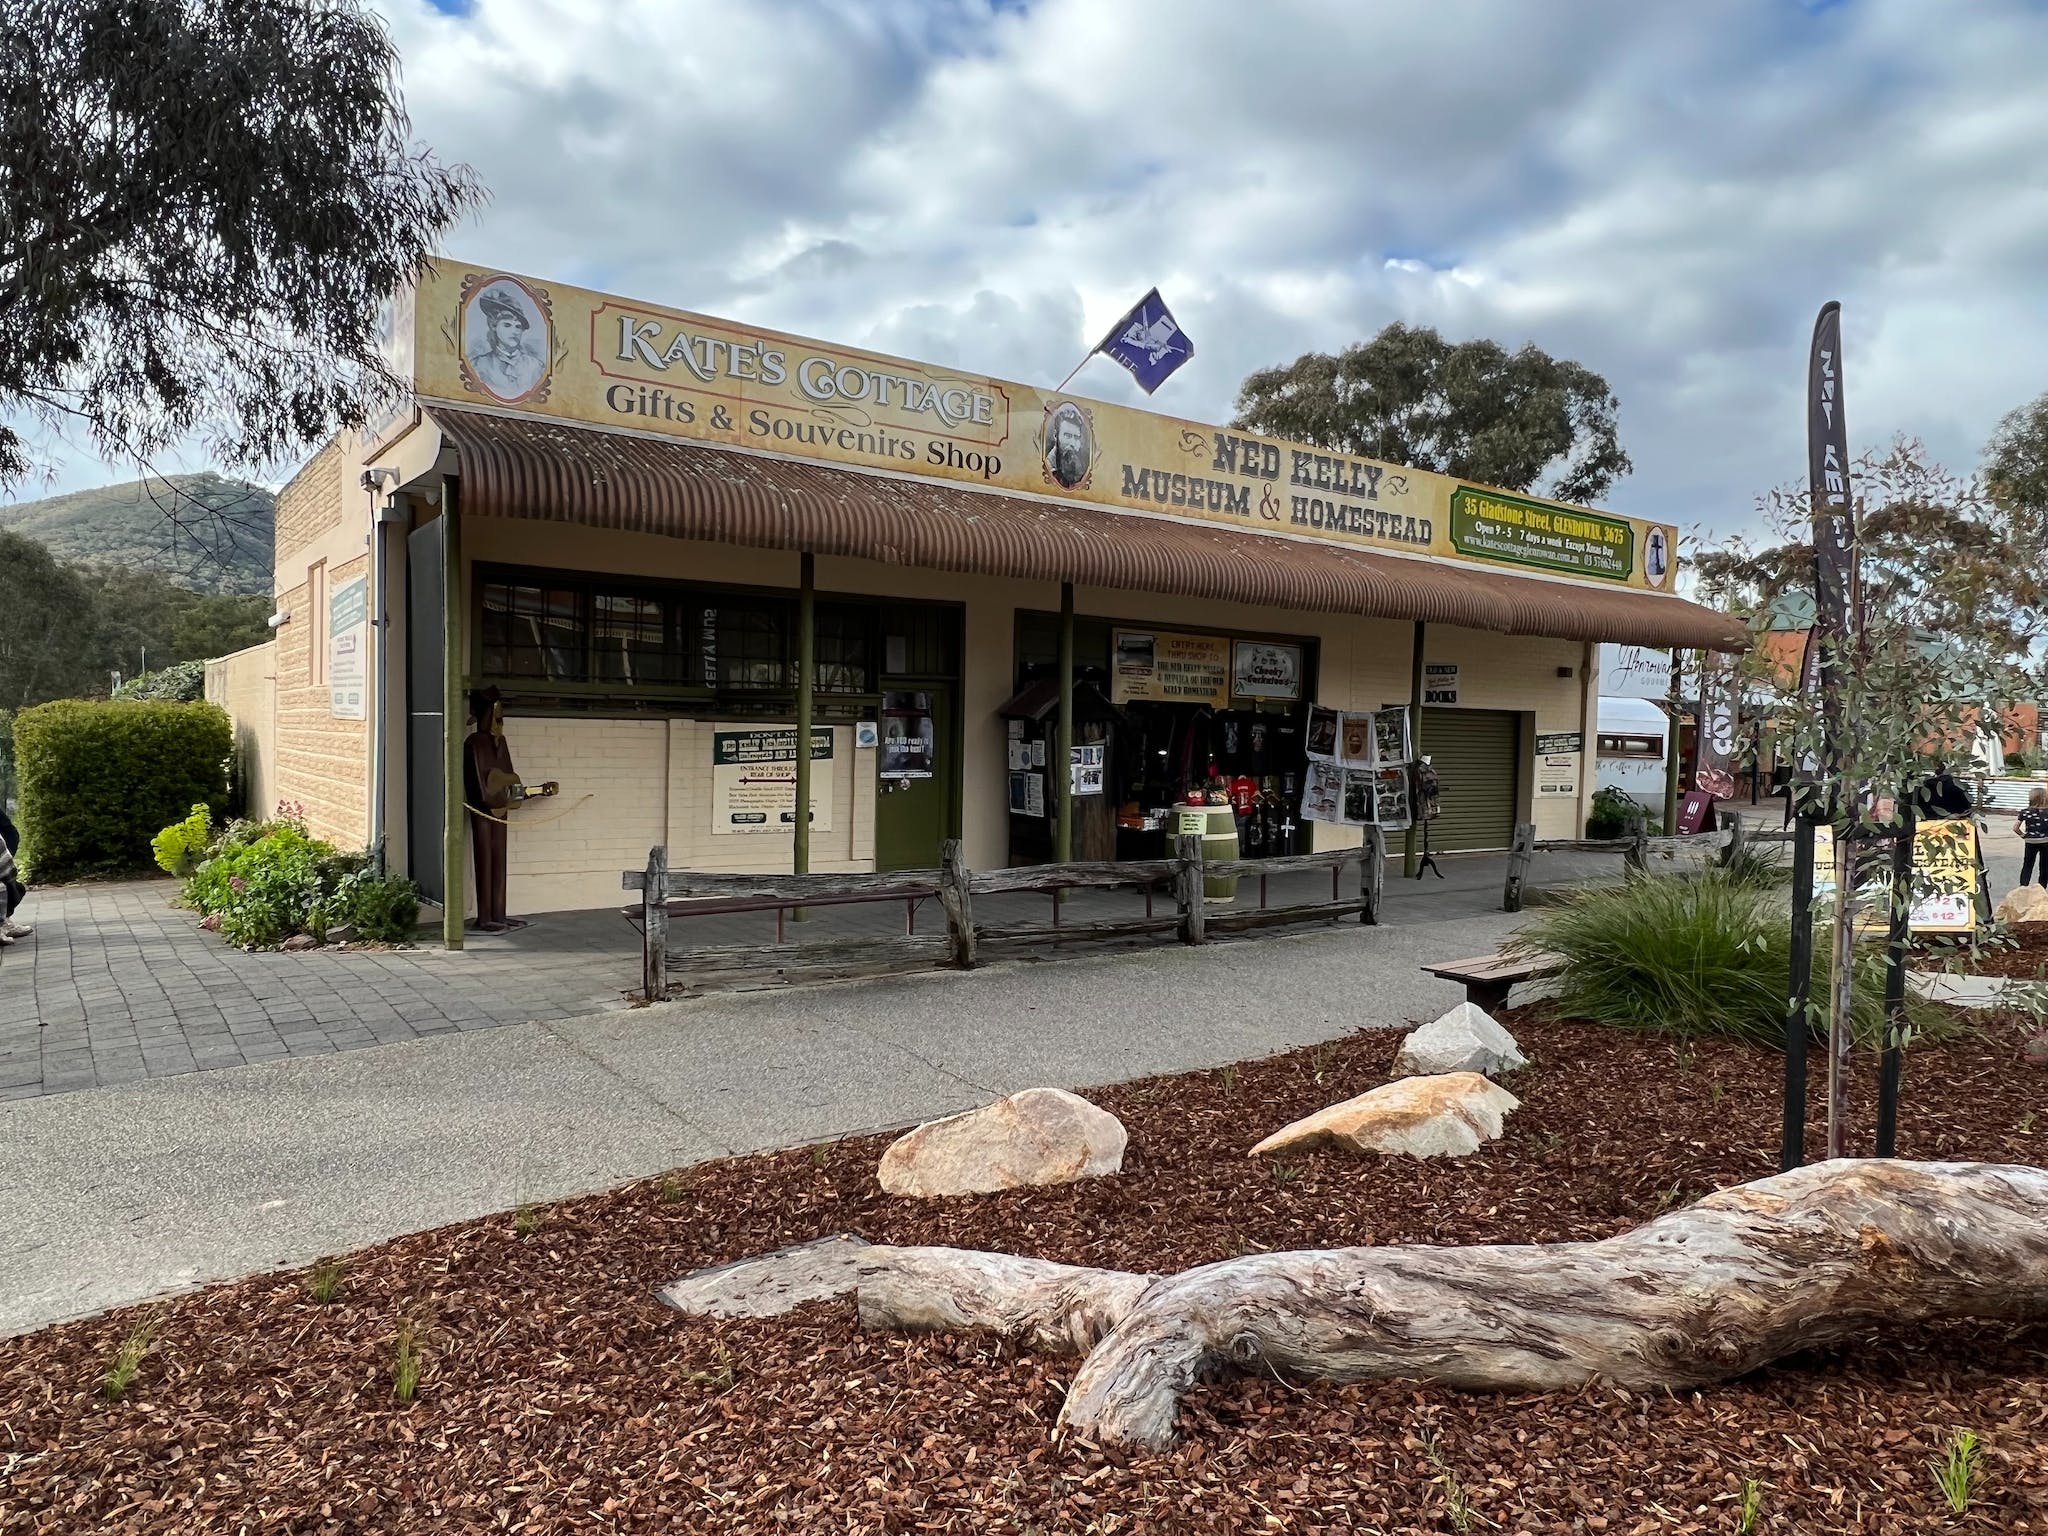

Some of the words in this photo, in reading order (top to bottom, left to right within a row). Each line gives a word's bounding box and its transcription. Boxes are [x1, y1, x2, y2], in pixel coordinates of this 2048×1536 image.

[616, 315, 788, 385] KATE'S
[797, 356, 994, 429] COTTAGE
[606, 384, 696, 424] Gifts
[710, 404, 736, 432] &
[748, 410, 916, 460] Souvenirs
[927, 440, 1002, 480] Shop
[1212, 432, 1281, 482] NED
[1290, 449, 1383, 501] KELLY
[1121, 464, 1251, 517] MUSEUM
[1259, 482, 1281, 522] &
[1290, 496, 1432, 547] HOMESTEAD
[1464, 497, 1477, 516] 35
[1479, 500, 1523, 525] Gladstone
[1604, 526, 1624, 545] 3675
[1475, 520, 1494, 535] Open
[1495, 524, 1501, 535] 9
[1507, 527, 1512, 538] 5
[1519, 529, 1525, 540] 7
[1526, 531, 1540, 545] days
[1546, 537, 1562, 548] week
[1565, 538, 1585, 553] Except
[1586, 542, 1602, 555] Xmas
[1603, 545, 1614, 558] Day
